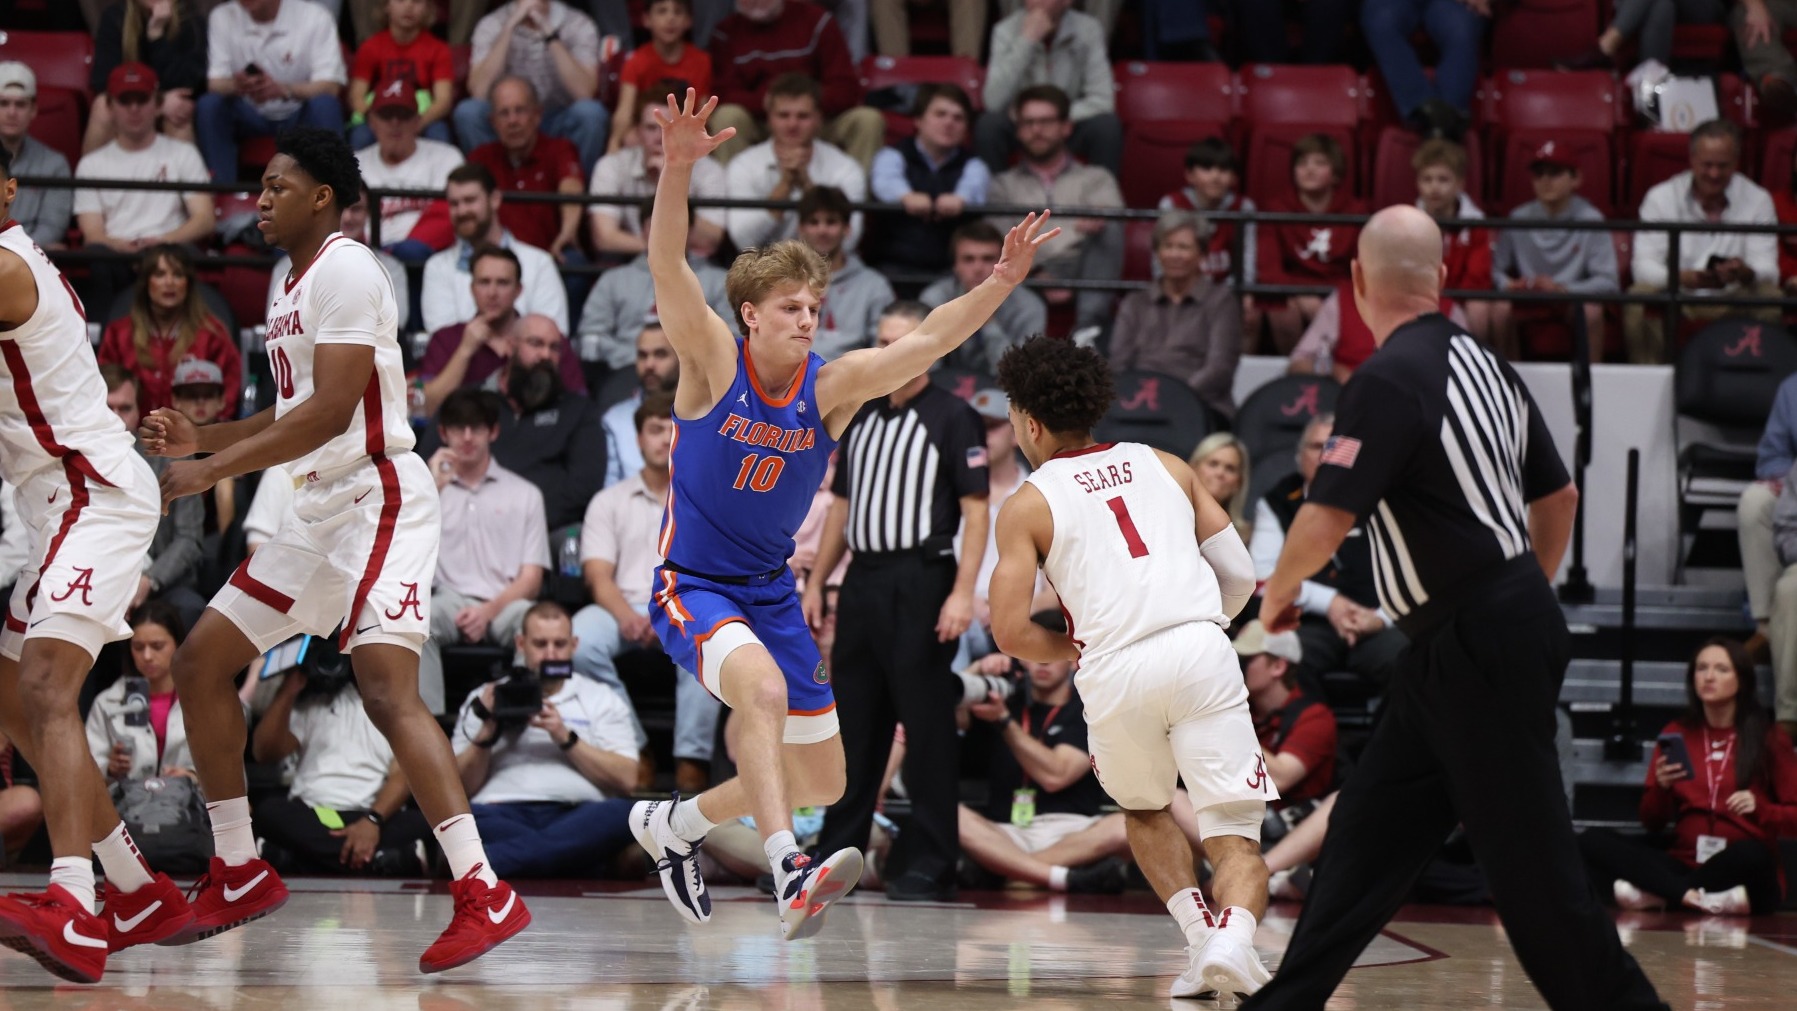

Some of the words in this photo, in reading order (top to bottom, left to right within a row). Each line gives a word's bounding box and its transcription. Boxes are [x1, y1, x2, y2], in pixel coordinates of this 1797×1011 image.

[1724, 324, 1762, 356] A
[271, 346, 295, 399] 10
[1121, 378, 1159, 411] A
[1281, 383, 1319, 416] A
[718, 413, 815, 453] FLORIDA
[733, 453, 785, 492] 10
[1073, 462, 1133, 493] SEARS
[1106, 496, 1150, 559] 1
[51, 565, 94, 606] A
[385, 582, 423, 621] A
[1246, 752, 1267, 794] A
